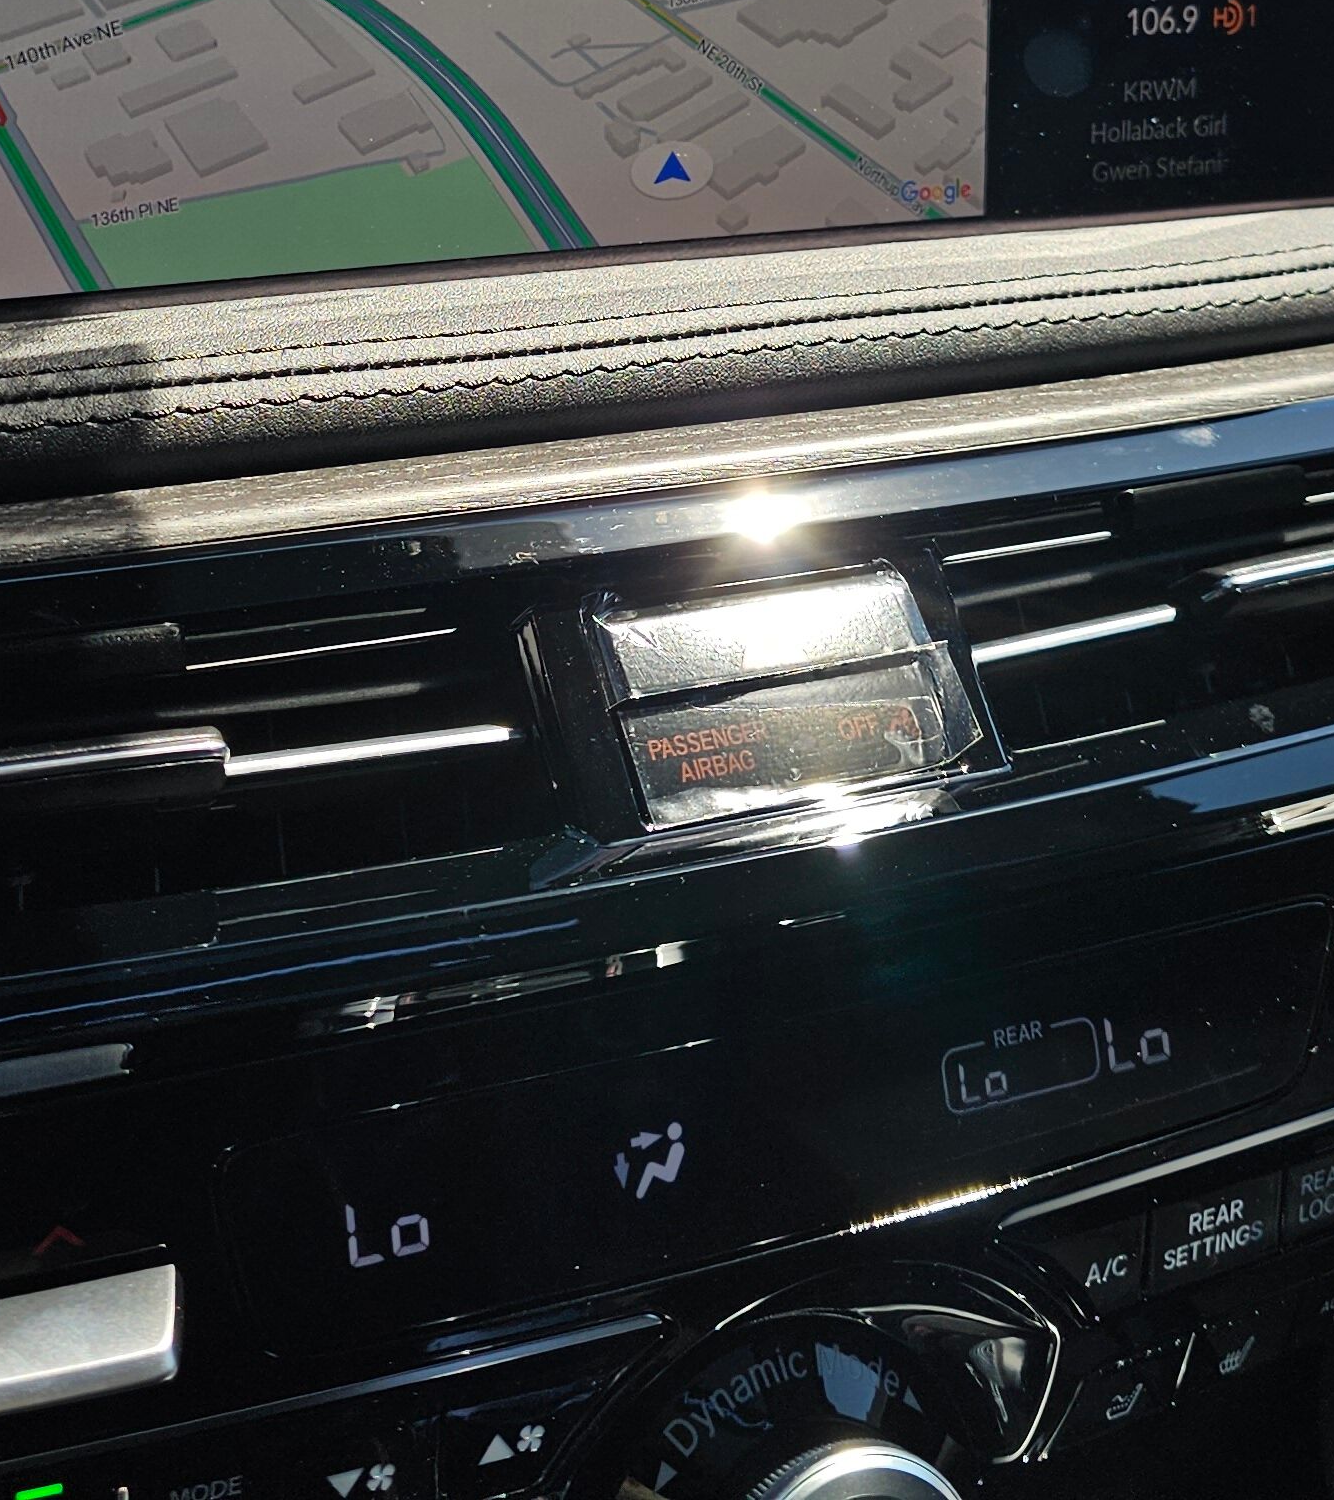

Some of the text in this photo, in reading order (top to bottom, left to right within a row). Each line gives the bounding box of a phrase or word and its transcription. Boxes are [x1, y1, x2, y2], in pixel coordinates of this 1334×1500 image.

[1127, 5, 1199, 37] 106.9
[4, 19, 124, 71] 140th Ave NE
[698, 38, 764, 95] NE 20th St
[1123, 76, 1197, 102] KRWM
[1091, 111, 1227, 144] Hollaback Girl
[854, 155, 900, 197] Northup
[1092, 159, 1149, 183] Gwen
[901, 177, 971, 204] Google
[91, 197, 180, 228] 136th Pl NE
[647, 720, 766, 761] PASSENGER
[837, 715, 878, 741] OFF
[680, 749, 757, 784] AIRBAG
[993, 1020, 1043, 1048] REAR
[1104, 1017, 1171, 1073] Lo
[958, 1063, 1008, 1103] Lo
[1188, 1199, 1244, 1233] REAR
[345, 1204, 429, 1268] Lo
[1163, 1220, 1263, 1270] SETTINGS
[1085, 1254, 1129, 1287] A/C
[663, 1347, 807, 1458] Dynamic
[170, 1475, 243, 1500] MODE
